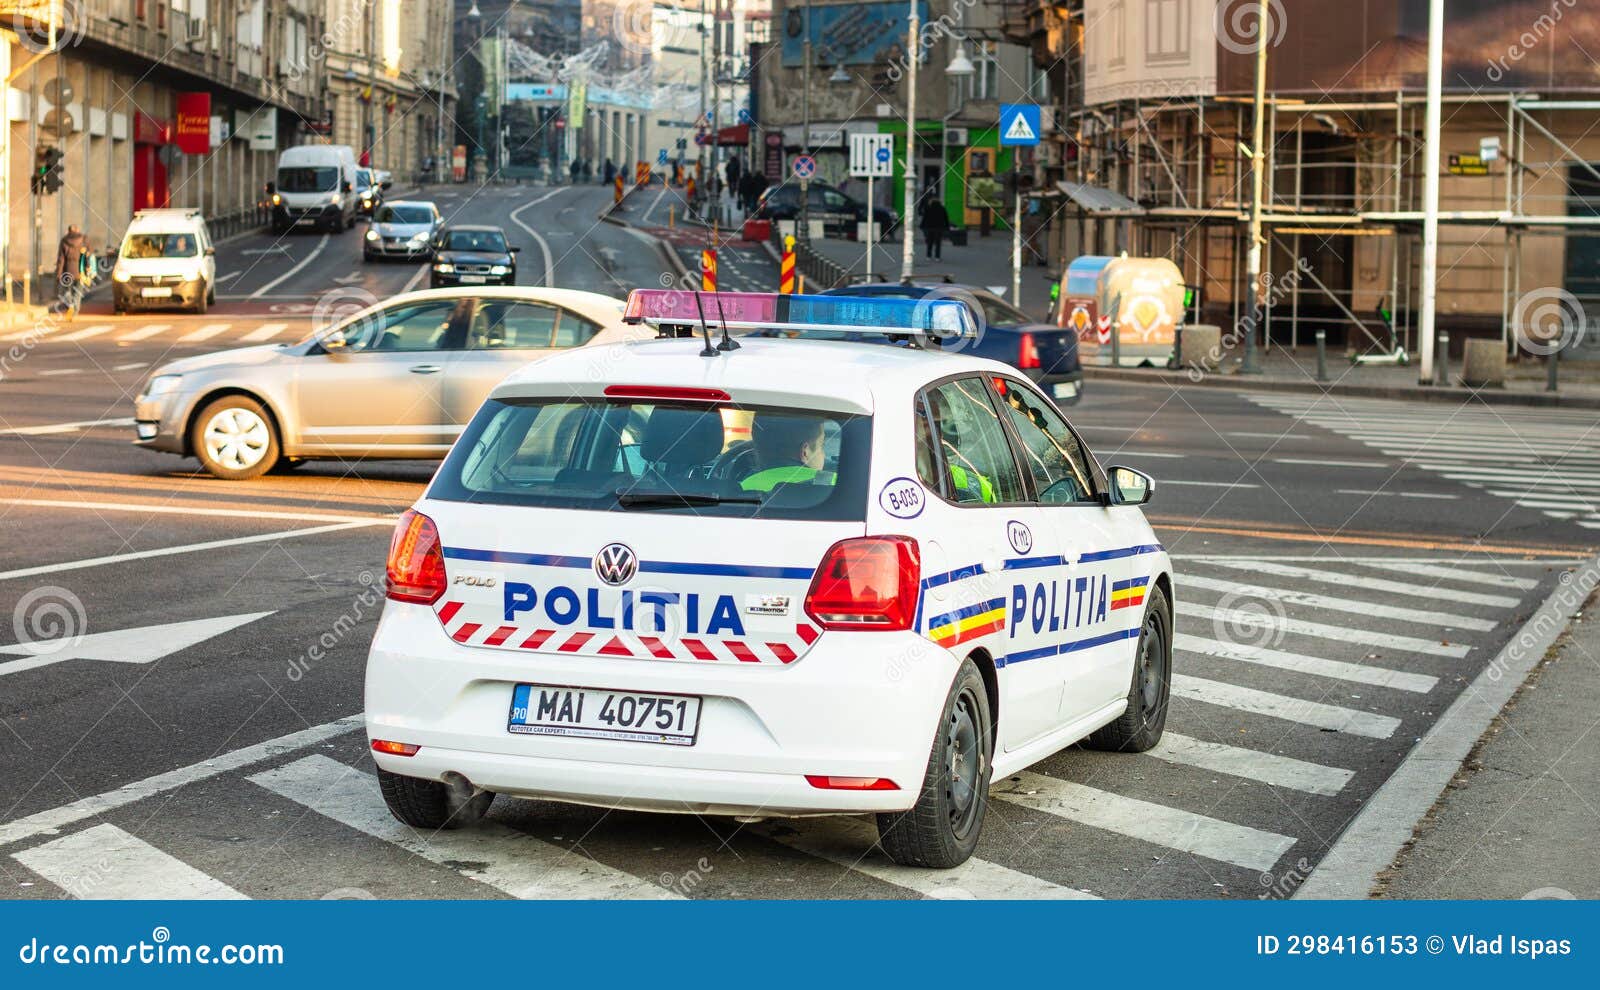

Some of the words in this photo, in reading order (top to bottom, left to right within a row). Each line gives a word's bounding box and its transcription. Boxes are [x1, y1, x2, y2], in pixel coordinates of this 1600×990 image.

[889, 487, 919, 511] B-035
[1018, 529, 1030, 541] 112
[453, 575, 496, 588] POLO
[504, 582, 746, 636] POLITIA
[1010, 574, 1107, 638] POLITIA
[513, 706, 526, 720] RO
[537, 690, 584, 723] MAI
[599, 694, 688, 732] 40751
